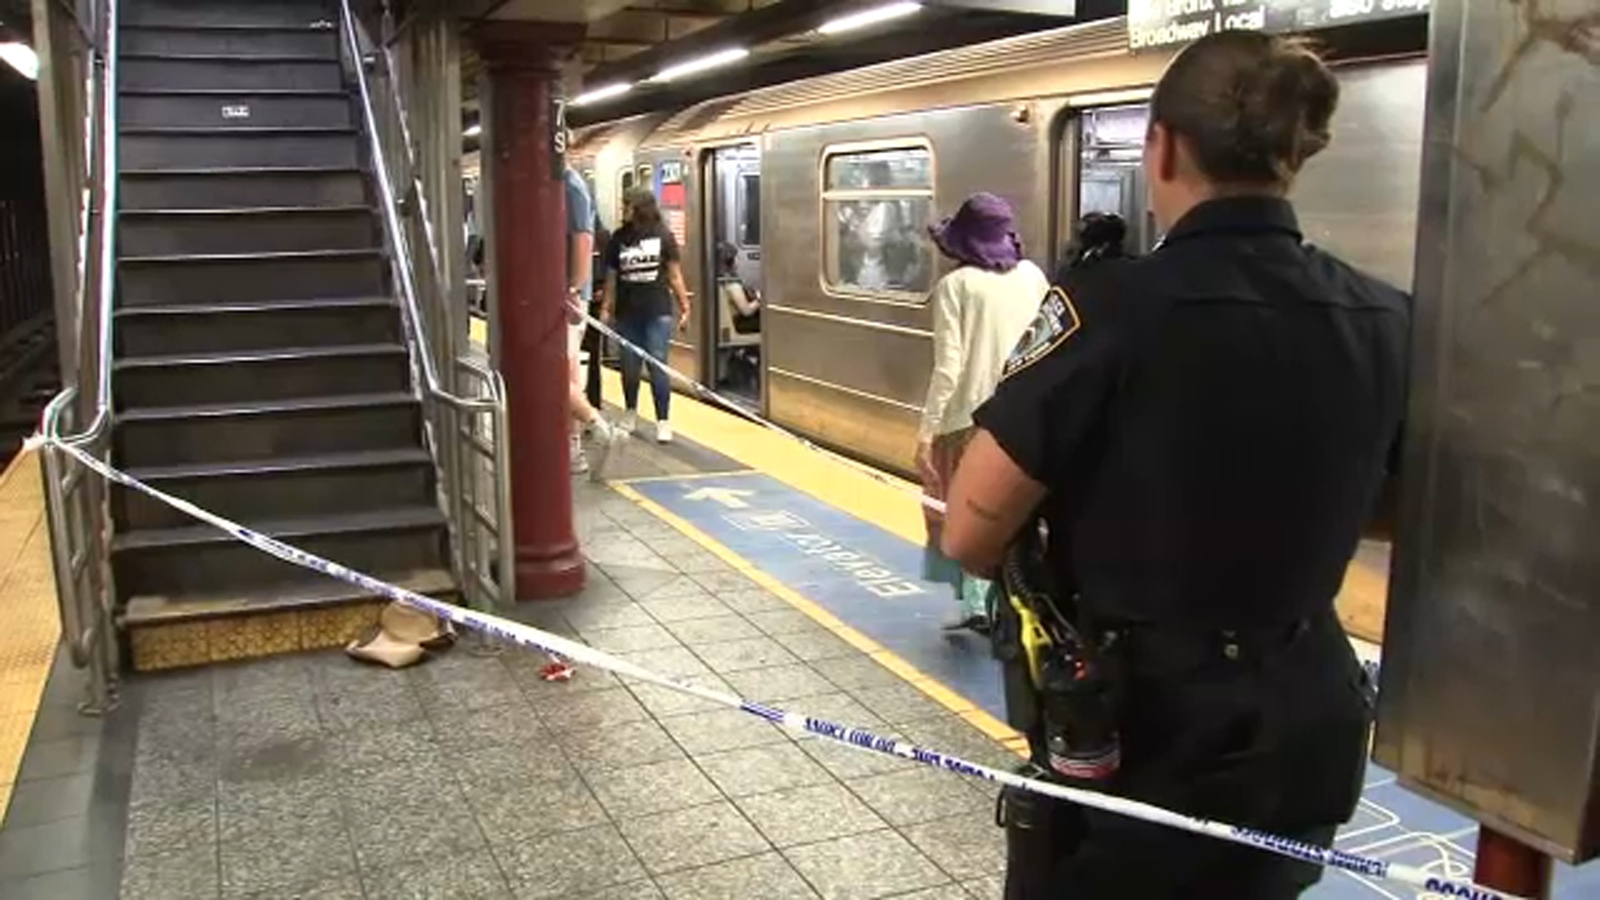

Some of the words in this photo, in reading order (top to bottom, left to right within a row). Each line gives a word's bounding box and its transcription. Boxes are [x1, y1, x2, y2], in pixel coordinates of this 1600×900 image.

[1130, 19, 1210, 48] Broadway
[1215, 4, 1265, 32] Local
[781, 532, 924, 598] Elevator
